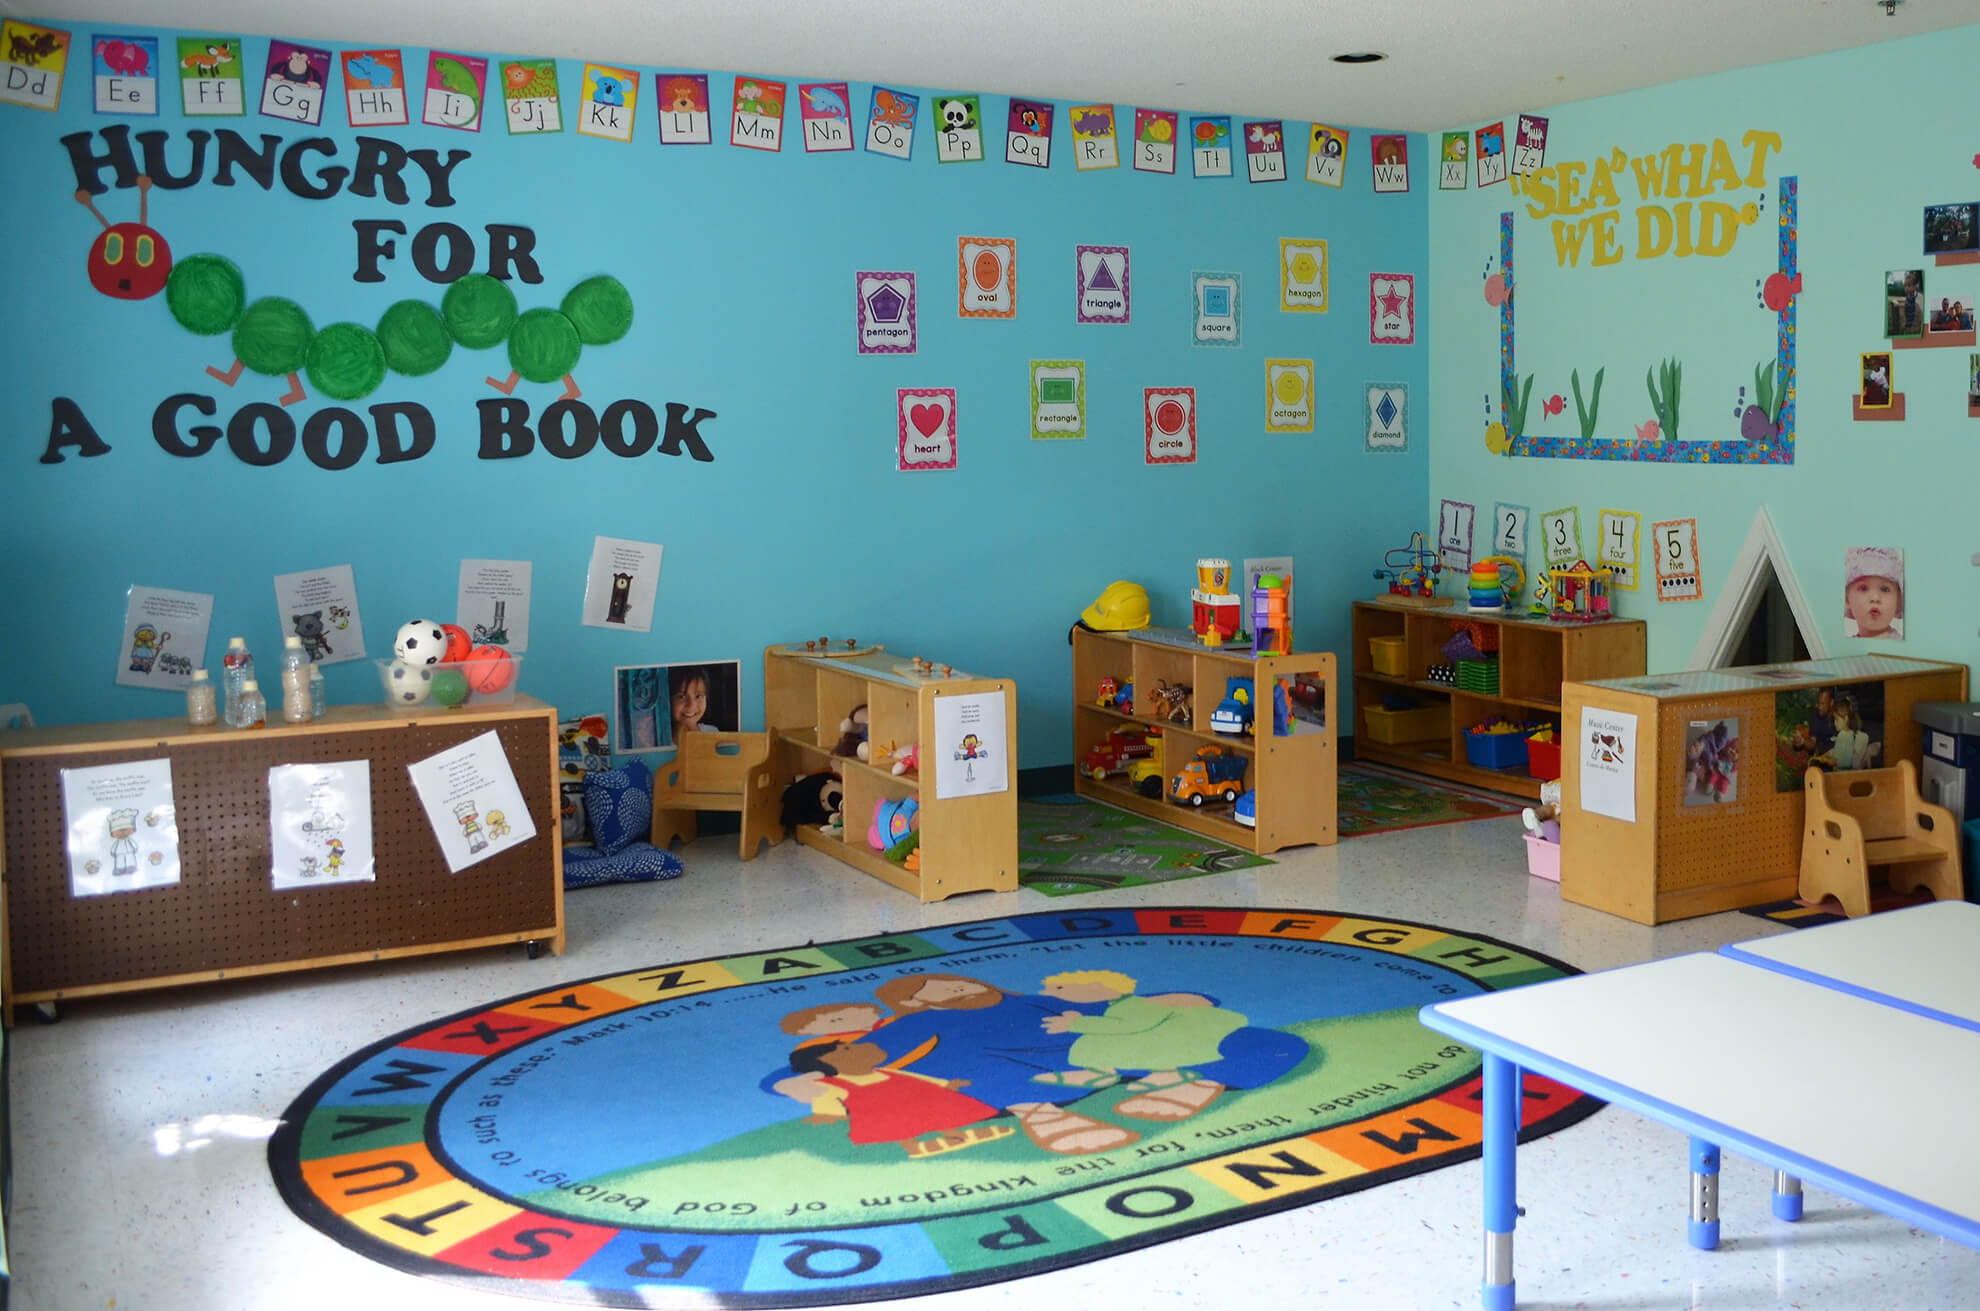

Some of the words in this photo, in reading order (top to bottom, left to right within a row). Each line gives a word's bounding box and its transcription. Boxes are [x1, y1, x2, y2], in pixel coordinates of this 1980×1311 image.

[6, 66, 47, 95] Dd
[109, 79, 141, 103] Ee
[200, 81, 227, 104] Ff
[272, 85, 311, 121] Gg
[358, 93, 393, 114] Hh
[444, 95, 461, 117] Ii
[523, 101, 544, 130] Jj
[591, 105, 619, 128] Kk
[674, 114, 694, 134] Ll
[736, 116, 775, 142] Mm
[811, 121, 842, 141] Nn
[873, 126, 904, 149] Oo
[946, 133, 972, 158] Pp
[1012, 136, 1042, 166] Qq
[1085, 143, 1105, 160] Rr
[1144, 145, 1163, 164] Ss
[60, 124, 471, 207] HUNGRY
[1202, 151, 1220, 169] Tt
[1254, 156, 1278, 174] Uu
[1519, 147, 1537, 168] Zz
[1631, 130, 1782, 202] WHAT
[1314, 158, 1335, 178] Vv
[1376, 167, 1406, 185] Ww
[1446, 164, 1462, 183] Xx
[1483, 158, 1499, 182] Yy
[1551, 209, 1624, 268] WE
[1635, 201, 1740, 259] DID
[352, 219, 545, 285] FOR
[977, 293, 997, 302] oval
[1086, 298, 1122, 309] triangle
[1288, 288, 1321, 299] hexagon
[866, 327, 909, 338] pentagon
[1201, 324, 1231, 333] square
[1384, 321, 1400, 330] star
[1039, 413, 1077, 423] rectangle
[1273, 409, 1307, 419] octagon
[39, 397, 112, 464] A
[151, 393, 437, 471] GOOD
[476, 398, 718, 463] BOOK
[1372, 431, 1401, 439] diamond
[914, 444, 941, 453] heart
[1158, 439, 1183, 449] circle
[1453, 510, 1458, 536] 1
[1505, 513, 1516, 539] 2
[1554, 519, 1567, 545] 3
[1611, 520, 1624, 548] 4
[1504, 540, 1516, 549] two
[1553, 547, 1572, 557] three
[1610, 549, 1626, 559] four
[1667, 530, 1681, 559] 5
[1669, 562, 1685, 571] five
[1060, 917, 1113, 932] D
[1169, 914, 1207, 928] E
[1270, 918, 1316, 932] F
[952, 926, 1009, 942] C
[1168, 939, 1234, 948] little
[1352, 929, 1410, 945] G
[855, 942, 912, 958] B
[1253, 943, 1361, 963] children
[1438, 946, 1510, 968] H
[763, 957, 822, 975] A
[897, 965, 925, 975] to
[1373, 961, 1433, 981] come
[637, 970, 706, 991] Z
[824, 972, 880, 987] said
[1431, 983, 1457, 995] to
[528, 994, 592, 1011] Y
[635, 1000, 713, 1022] 10:14
[443, 1020, 532, 1045] X
[561, 1022, 633, 1046] Mark
[1437, 1045, 1467, 1058] do
[351, 1060, 447, 1097] W
[1401, 1062, 1440, 1083] not
[478, 1094, 503, 1107] as
[1308, 1081, 1399, 1117] hinder
[331, 1114, 411, 1142] V
[465, 1114, 501, 1144] such
[1360, 1117, 1462, 1155] M
[491, 1151, 522, 1166] to
[1137, 1141, 1186, 1158] for
[1056, 1157, 1116, 1177] the
[1224, 1150, 1326, 1190] N
[332, 1160, 419, 1196] U
[524, 1168, 650, 1212] belongs
[859, 1175, 1037, 1209] kingdom
[674, 1201, 758, 1217] God
[787, 1201, 828, 1216] of
[1105, 1185, 1195, 1219] O
[379, 1200, 473, 1237] T
[978, 1214, 1051, 1251] P
[489, 1227, 574, 1261] S
[625, 1243, 708, 1279] R
[783, 1239, 883, 1280] Q
